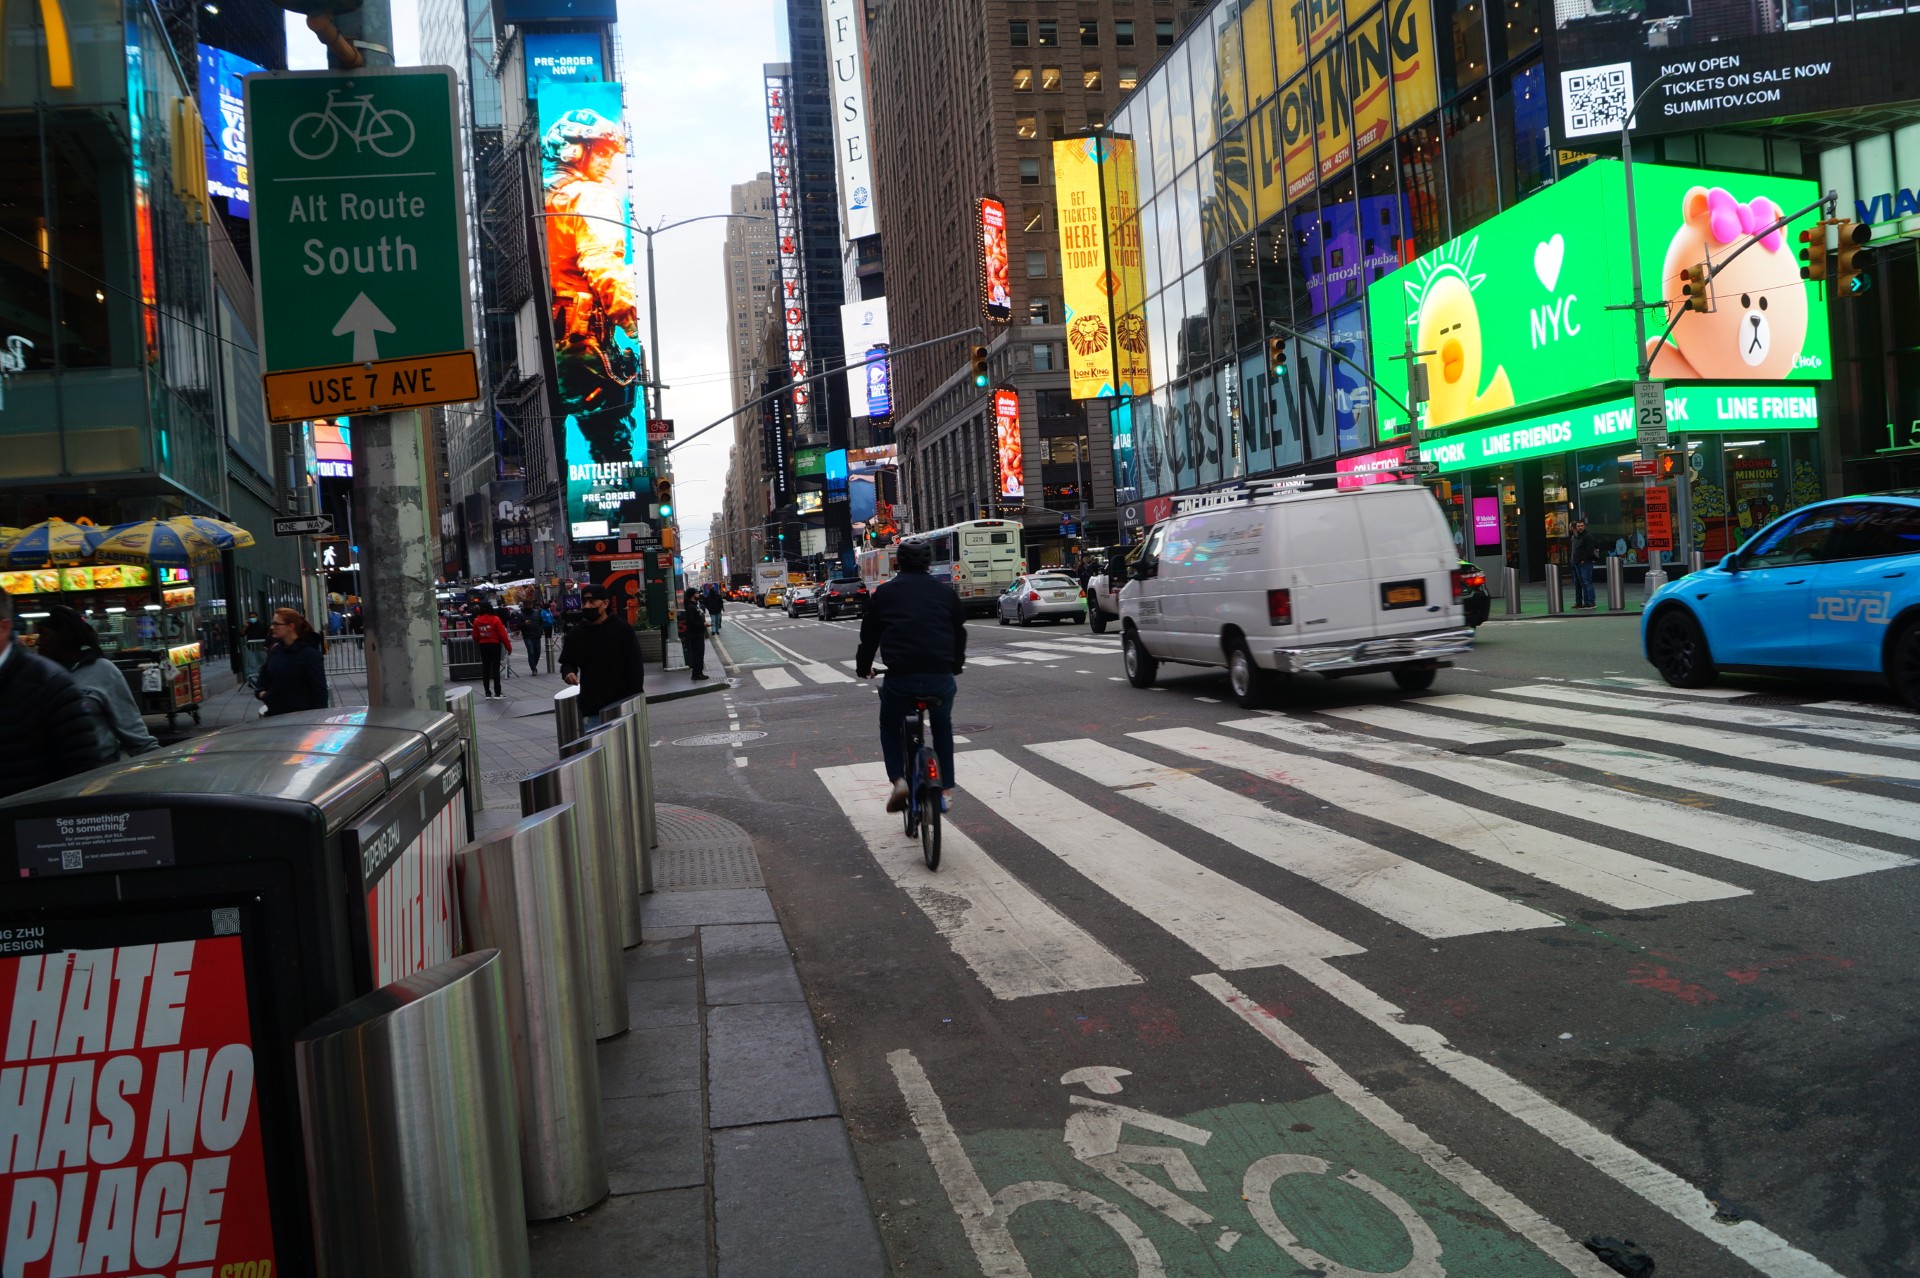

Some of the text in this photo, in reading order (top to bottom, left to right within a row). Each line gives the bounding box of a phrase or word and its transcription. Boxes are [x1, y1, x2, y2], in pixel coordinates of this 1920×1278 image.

[1291, 0, 1339, 46] THE
[534, 56, 594, 66] PRE-ORDER
[552, 66, 576, 74] NOW
[1661, 55, 1740, 77] NOW OPEN
[1662, 62, 1832, 96] TICKETS ON SALE NOW
[1256, 0, 1418, 189] LION KING
[1664, 89, 1781, 116] SUMMITOV.COM
[1289, 128, 1377, 196] ENTRANCE ON 45TH STREET
[288, 191, 425, 222] Alt Route
[1070, 190, 1085, 206] GET
[1062, 206, 1097, 224] TICKETS
[1065, 224, 1098, 249] HERE
[303, 236, 418, 276] South
[1067, 250, 1098, 269] TODAY
[1530, 294, 1581, 350] NYC
[309, 368, 436, 404] USE 7 AVE
[870, 383, 886, 391] TACO
[870, 389, 886, 398] BELL
[1640, 408, 1663, 424] 25
[1165, 391, 1224, 475] CBS
[1432, 442, 1466, 464] YORK
[1482, 433, 1511, 456] LINE
[1512, 420, 1572, 450] FRIENDS
[1594, 407, 1634, 436] NEW
[1717, 397, 1759, 420] LINE
[639, 468, 648, 476] 45
[1736, 459, 1772, 468] BROWN
[1736, 469, 1778, 480] MINIONS
[582, 492, 636, 502] PRE-ORDER
[598, 501, 620, 510] NOW
[278, 520, 325, 532] ONE WAY
[97, 550, 146, 564] SABRETT
[1808, 592, 1893, 624] revel
[56, 812, 130, 827] See something?
[61, 822, 128, 834] Do something.
[364, 820, 400, 879] ZIPENG ZHU
[16, 927, 45, 938] ZHU
[4, 940, 197, 1062] HATE
[0, 1043, 255, 1174] HAS NO
[1, 1155, 231, 1278] PLACE
